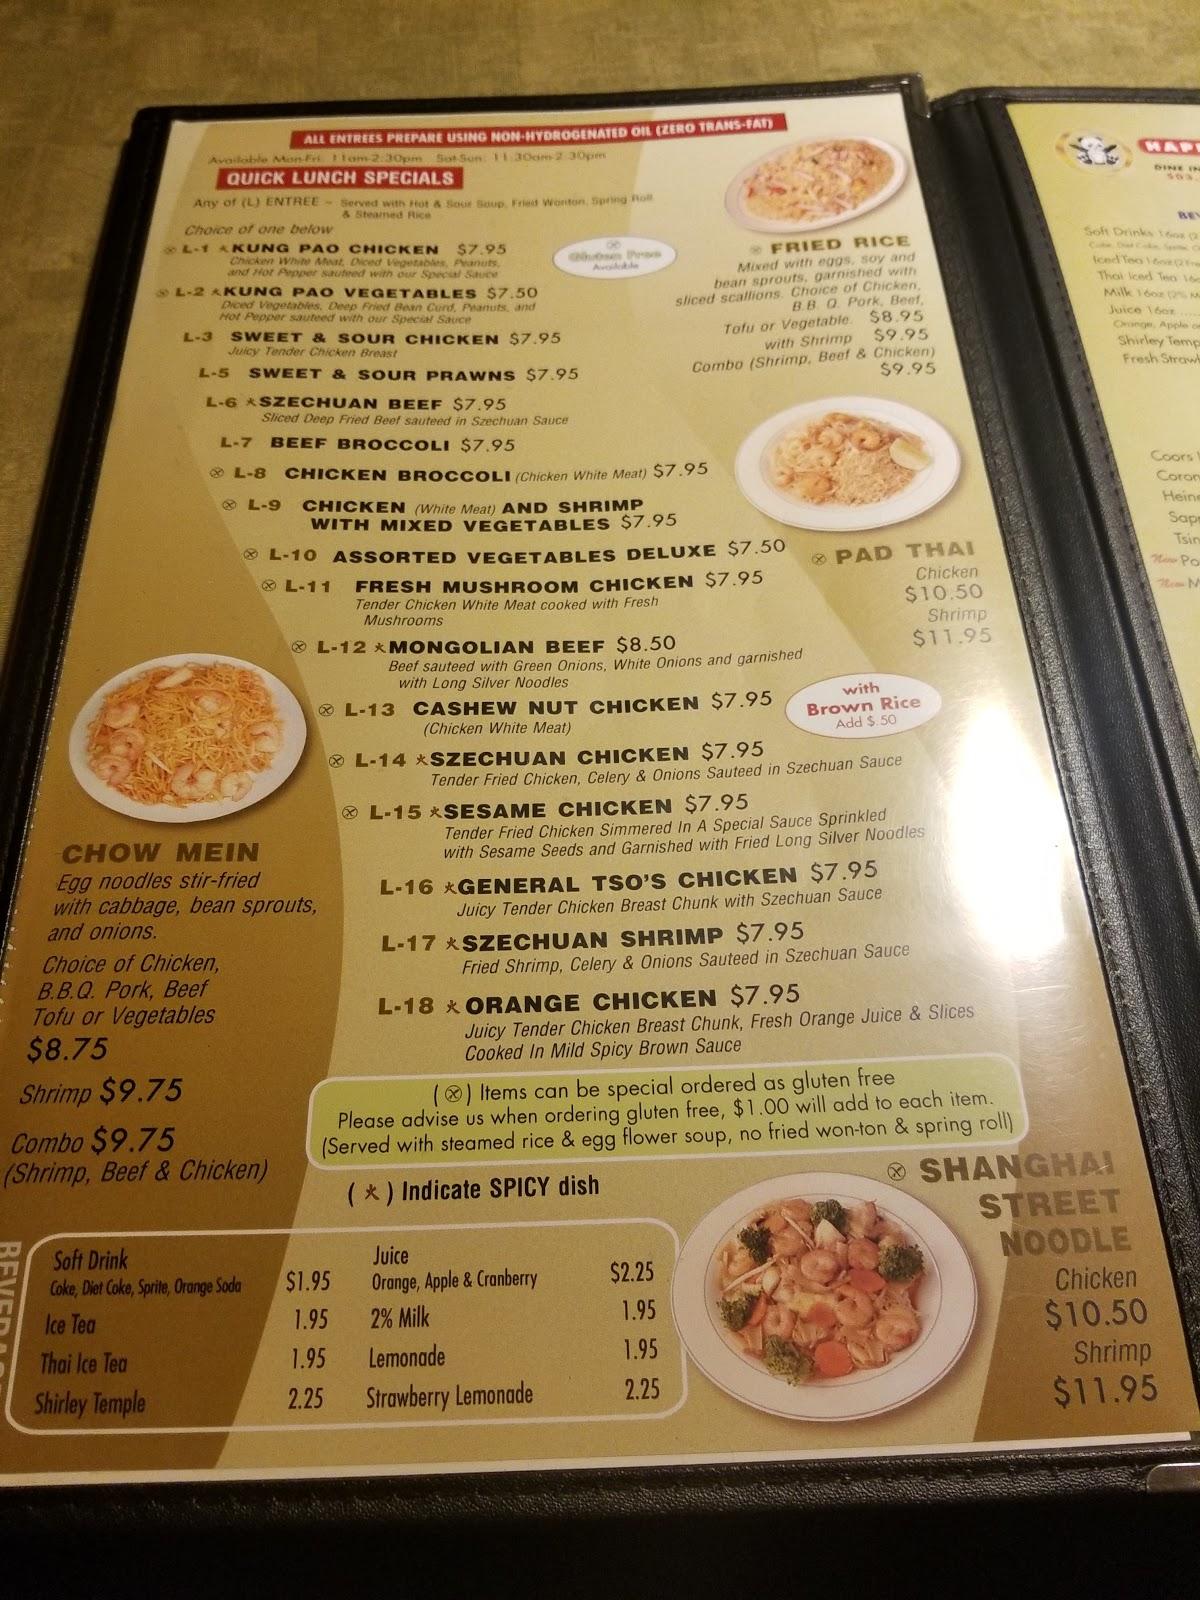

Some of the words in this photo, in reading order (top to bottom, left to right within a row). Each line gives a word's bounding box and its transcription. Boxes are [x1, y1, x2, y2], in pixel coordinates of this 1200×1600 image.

[304, 134, 325, 144] ALL
[329, 133, 383, 144] ENTREES
[387, 132, 442, 143] PREPARE
[447, 132, 487, 143] USING
[491, 127, 628, 142] NON-HYDROGENATED
[631, 126, 652, 137] OIL
[656, 123, 696, 136] (ZERO
[698, 117, 774, 132] TRANS-FAT)
[227, 171, 285, 186] QUICK
[292, 170, 357, 184] LUNCH
[363, 168, 455, 186] SPECIALS
[184, 225, 234, 236] Choice
[238, 224, 255, 235] of
[258, 225, 285, 234] one
[290, 224, 334, 235] below
[182, 244, 208, 254] L-1
[232, 243, 289, 253] KUNG
[299, 244, 339, 254] PAO
[349, 244, 438, 255] CHICKEN
[457, 243, 506, 256] $7.95
[771, 239, 842, 255] FRIED
[854, 235, 910, 248] RICE
[175, 287, 205, 297] L-2
[224, 286, 282, 297] KUNG
[292, 287, 334, 297] PAO
[344, 288, 477, 299] VEGETABLES
[487, 286, 538, 300] $7.50
[183, 331, 213, 342] L-3
[231, 331, 303, 342] SWEET
[312, 332, 326, 343] &
[338, 333, 395, 344] SOUR
[405, 334, 498, 345] CHICKEN
[509, 332, 561, 346] $7.95
[227, 346, 259, 357] Juicy
[265, 346, 306, 357] Tender
[309, 346, 356, 358] Chicken
[360, 348, 398, 358] Breast
[692, 359, 744, 373] Combo
[749, 355, 811, 371] (Shrimp,
[818, 348, 850, 362] Beef
[856, 348, 866, 360] &
[873, 346, 935, 359] Chicken)
[880, 362, 936, 377] $9.95
[206, 396, 237, 408] L-6
[259, 396, 377, 409] SZECHUAN
[389, 399, 442, 410] BEEF
[453, 397, 506, 412] $7.95
[234, 467, 266, 479] L-8
[285, 467, 386, 481] CHICKEN
[398, 470, 510, 482] BROCCOLI
[515, 471, 568, 484] (Chicken
[574, 470, 608, 481] White
[612, 468, 647, 480] Meat)
[654, 462, 708, 479] $7.95
[835, 545, 893, 565] PAD
[905, 541, 975, 558] THAI
[285, 579, 330, 593] L-11
[356, 580, 431, 593] FRESH
[443, 581, 578, 594] MUSHROOM
[589, 575, 693, 593] CHICKEN
[705, 570, 763, 589] $7.95
[916, 565, 978, 581] Chicken
[356, 599, 401, 610] Tender
[405, 598, 456, 610] Chicken
[462, 599, 499, 610] White
[504, 599, 536, 610] Meat
[540, 599, 587, 611] cooked
[592, 597, 619, 610] with
[624, 595, 659, 608] Fresh
[905, 583, 983, 604] $10.50
[364, 614, 444, 626] Mushrooms
[928, 607, 987, 623] Shrimp
[317, 640, 366, 654] L-12
[389, 640, 534, 654] MONGOLIAN
[546, 640, 605, 653] BEEF
[617, 635, 676, 654] $8.50
[913, 627, 992, 648] $11.95
[842, 682, 880, 695] with
[807, 702, 873, 716] Brown
[880, 696, 921, 710] Rice
[836, 715, 863, 729] Add
[867, 714, 897, 727] $.50
[370, 805, 422, 820] L-15
[444, 803, 546, 820] SESAME
[558, 799, 672, 817] CHICKEN
[685, 793, 748, 815] $7.95
[62, 843, 162, 864] CHOW
[176, 842, 259, 862] MEIN
[56, 874, 93, 895] Egg
[98, 872, 173, 890] noodles
[179, 871, 261, 889] stir-fried
[54, 898, 92, 916] with
[98, 897, 180, 918] cabbage,
[190, 896, 235, 914] bean
[242, 897, 316, 917] sprouts,
[378, 997, 434, 1015] L-18
[465, 994, 580, 1015] ORANGE
[593, 989, 716, 1011] CHICKEN
[731, 983, 800, 1008] $7.95
[465, 1023, 506, 1041] Juicy
[513, 1021, 566, 1037] Tender
[571, 1019, 630, 1035] Chicken
[637, 1017, 686, 1033] Breast
[691, 1014, 743, 1031] Chunk,
[751, 1012, 792, 1029] Fresh
[799, 1011, 855, 1028] Orange
[861, 1007, 902, 1024] Juice
[909, 1005, 921, 1021] &
[928, 1003, 974, 1020] Slices
[27, 1035, 108, 1064] $8.75
[19, 1083, 92, 1108] Shrimp
[100, 1076, 183, 1106] $9.75
[481, 1083, 527, 1101] Items
[534, 1086, 568, 1099] can
[577, 1078, 600, 1098] be
[608, 1075, 673, 1102] special
[681, 1072, 756, 1094] ordered
[764, 1078, 785, 1091] as
[792, 1070, 850, 1095] gluten
[858, 1067, 895, 1086] free
[920, 1153, 1113, 1183] SHANGHAI
[402, 1179, 481, 1201] Indicate
[490, 1176, 550, 1198] SPICY
[559, 1174, 599, 1196] dish
[979, 1188, 1120, 1220] STREET
[999, 1224, 1132, 1257] NOODLE
[53, 1248, 83, 1271] Soft
[88, 1247, 128, 1270] Drink
[373, 1245, 409, 1266] Juice
[286, 1270, 330, 1293] $1.95
[610, 1261, 654, 1284] $2.25
[1056, 1266, 1137, 1291] Chicken
[50, 1278, 78, 1299] Coke,
[82, 1279, 104, 1296] Diet
[106, 1278, 134, 1298] Coke,
[138, 1278, 170, 1299] Sprite,
[174, 1277, 213, 1298] Orange
[216, 1275, 242, 1293] Soda
[1045, 1297, 1148, 1331] $10.50
[1074, 1339, 1151, 1367] Shrimp
[367, 1384, 450, 1412] Strawberry
[456, 1380, 533, 1406] Lemonade
[625, 1378, 660, 1400] 2.25
[1053, 1374, 1158, 1409] $11.95
[34, 1390, 88, 1420] Shirley
[93, 1389, 146, 1420] Temple
[288, 1387, 323, 1409] 2.25
